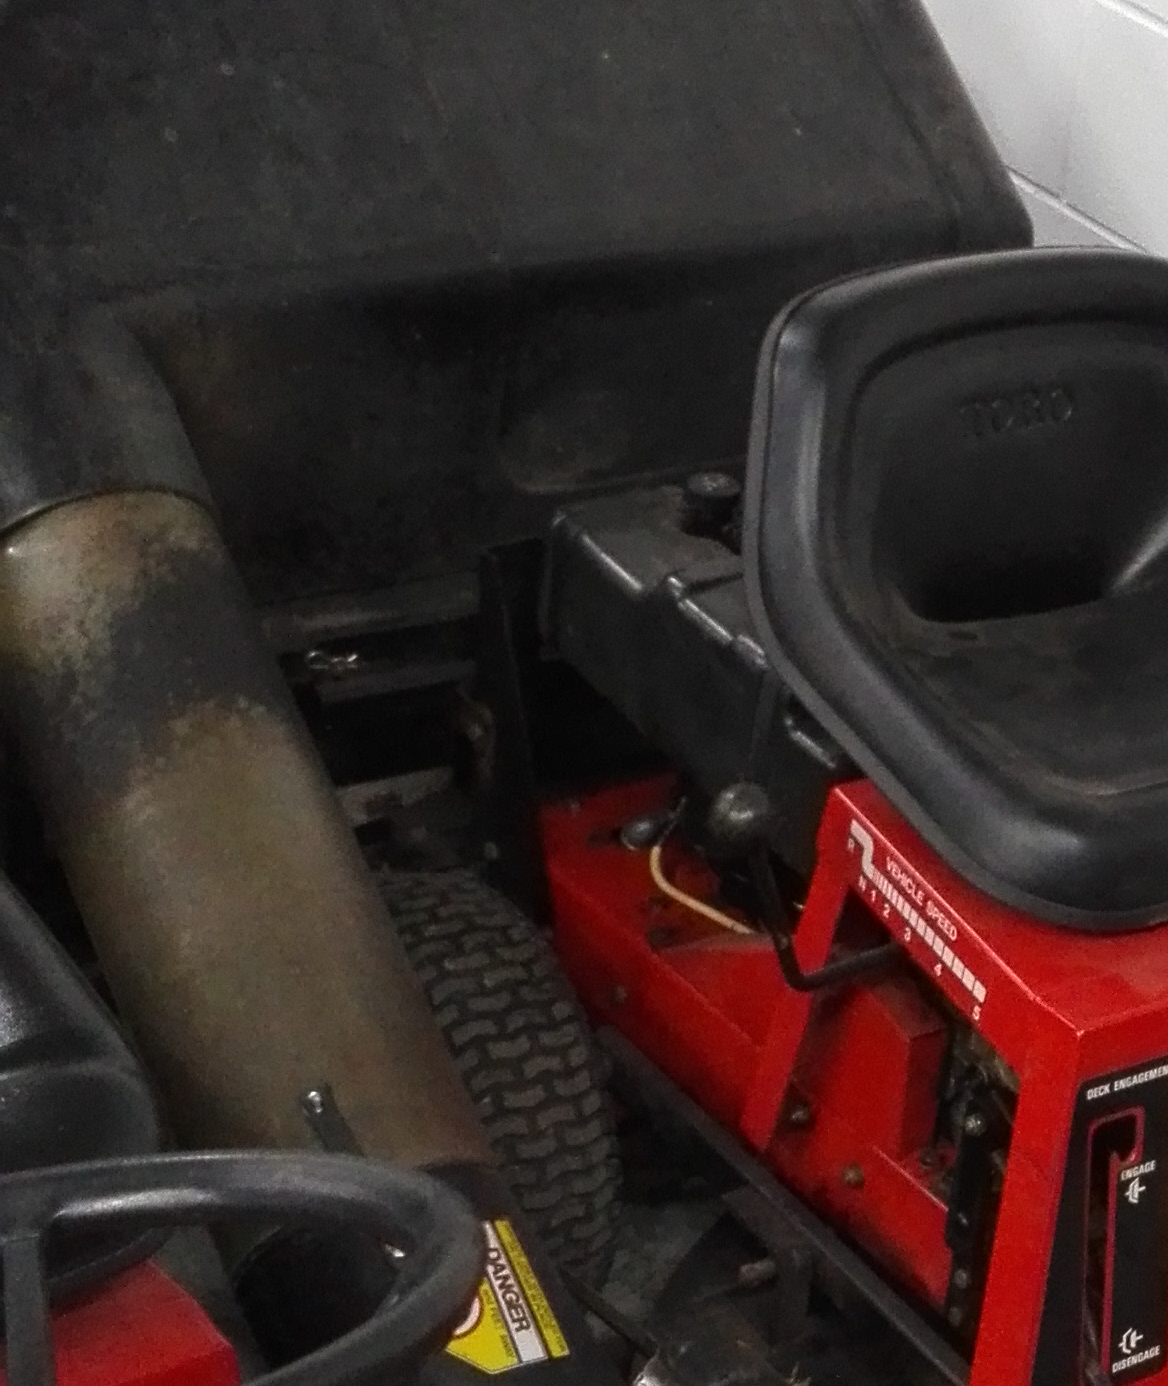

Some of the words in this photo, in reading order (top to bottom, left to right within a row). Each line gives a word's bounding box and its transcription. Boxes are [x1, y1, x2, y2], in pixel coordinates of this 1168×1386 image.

[886, 856, 925, 906] VEHICLE
[926, 900, 957, 941] SPEED
[883, 904, 890, 918] 2
[972, 1005, 981, 1021] 5
[1086, 1083, 1110, 1100] DECK
[1121, 1160, 1156, 1181] ENGAGE
[488, 1247, 530, 1332] DANGER
[1112, 1345, 1160, 1373] DISENGAGE
